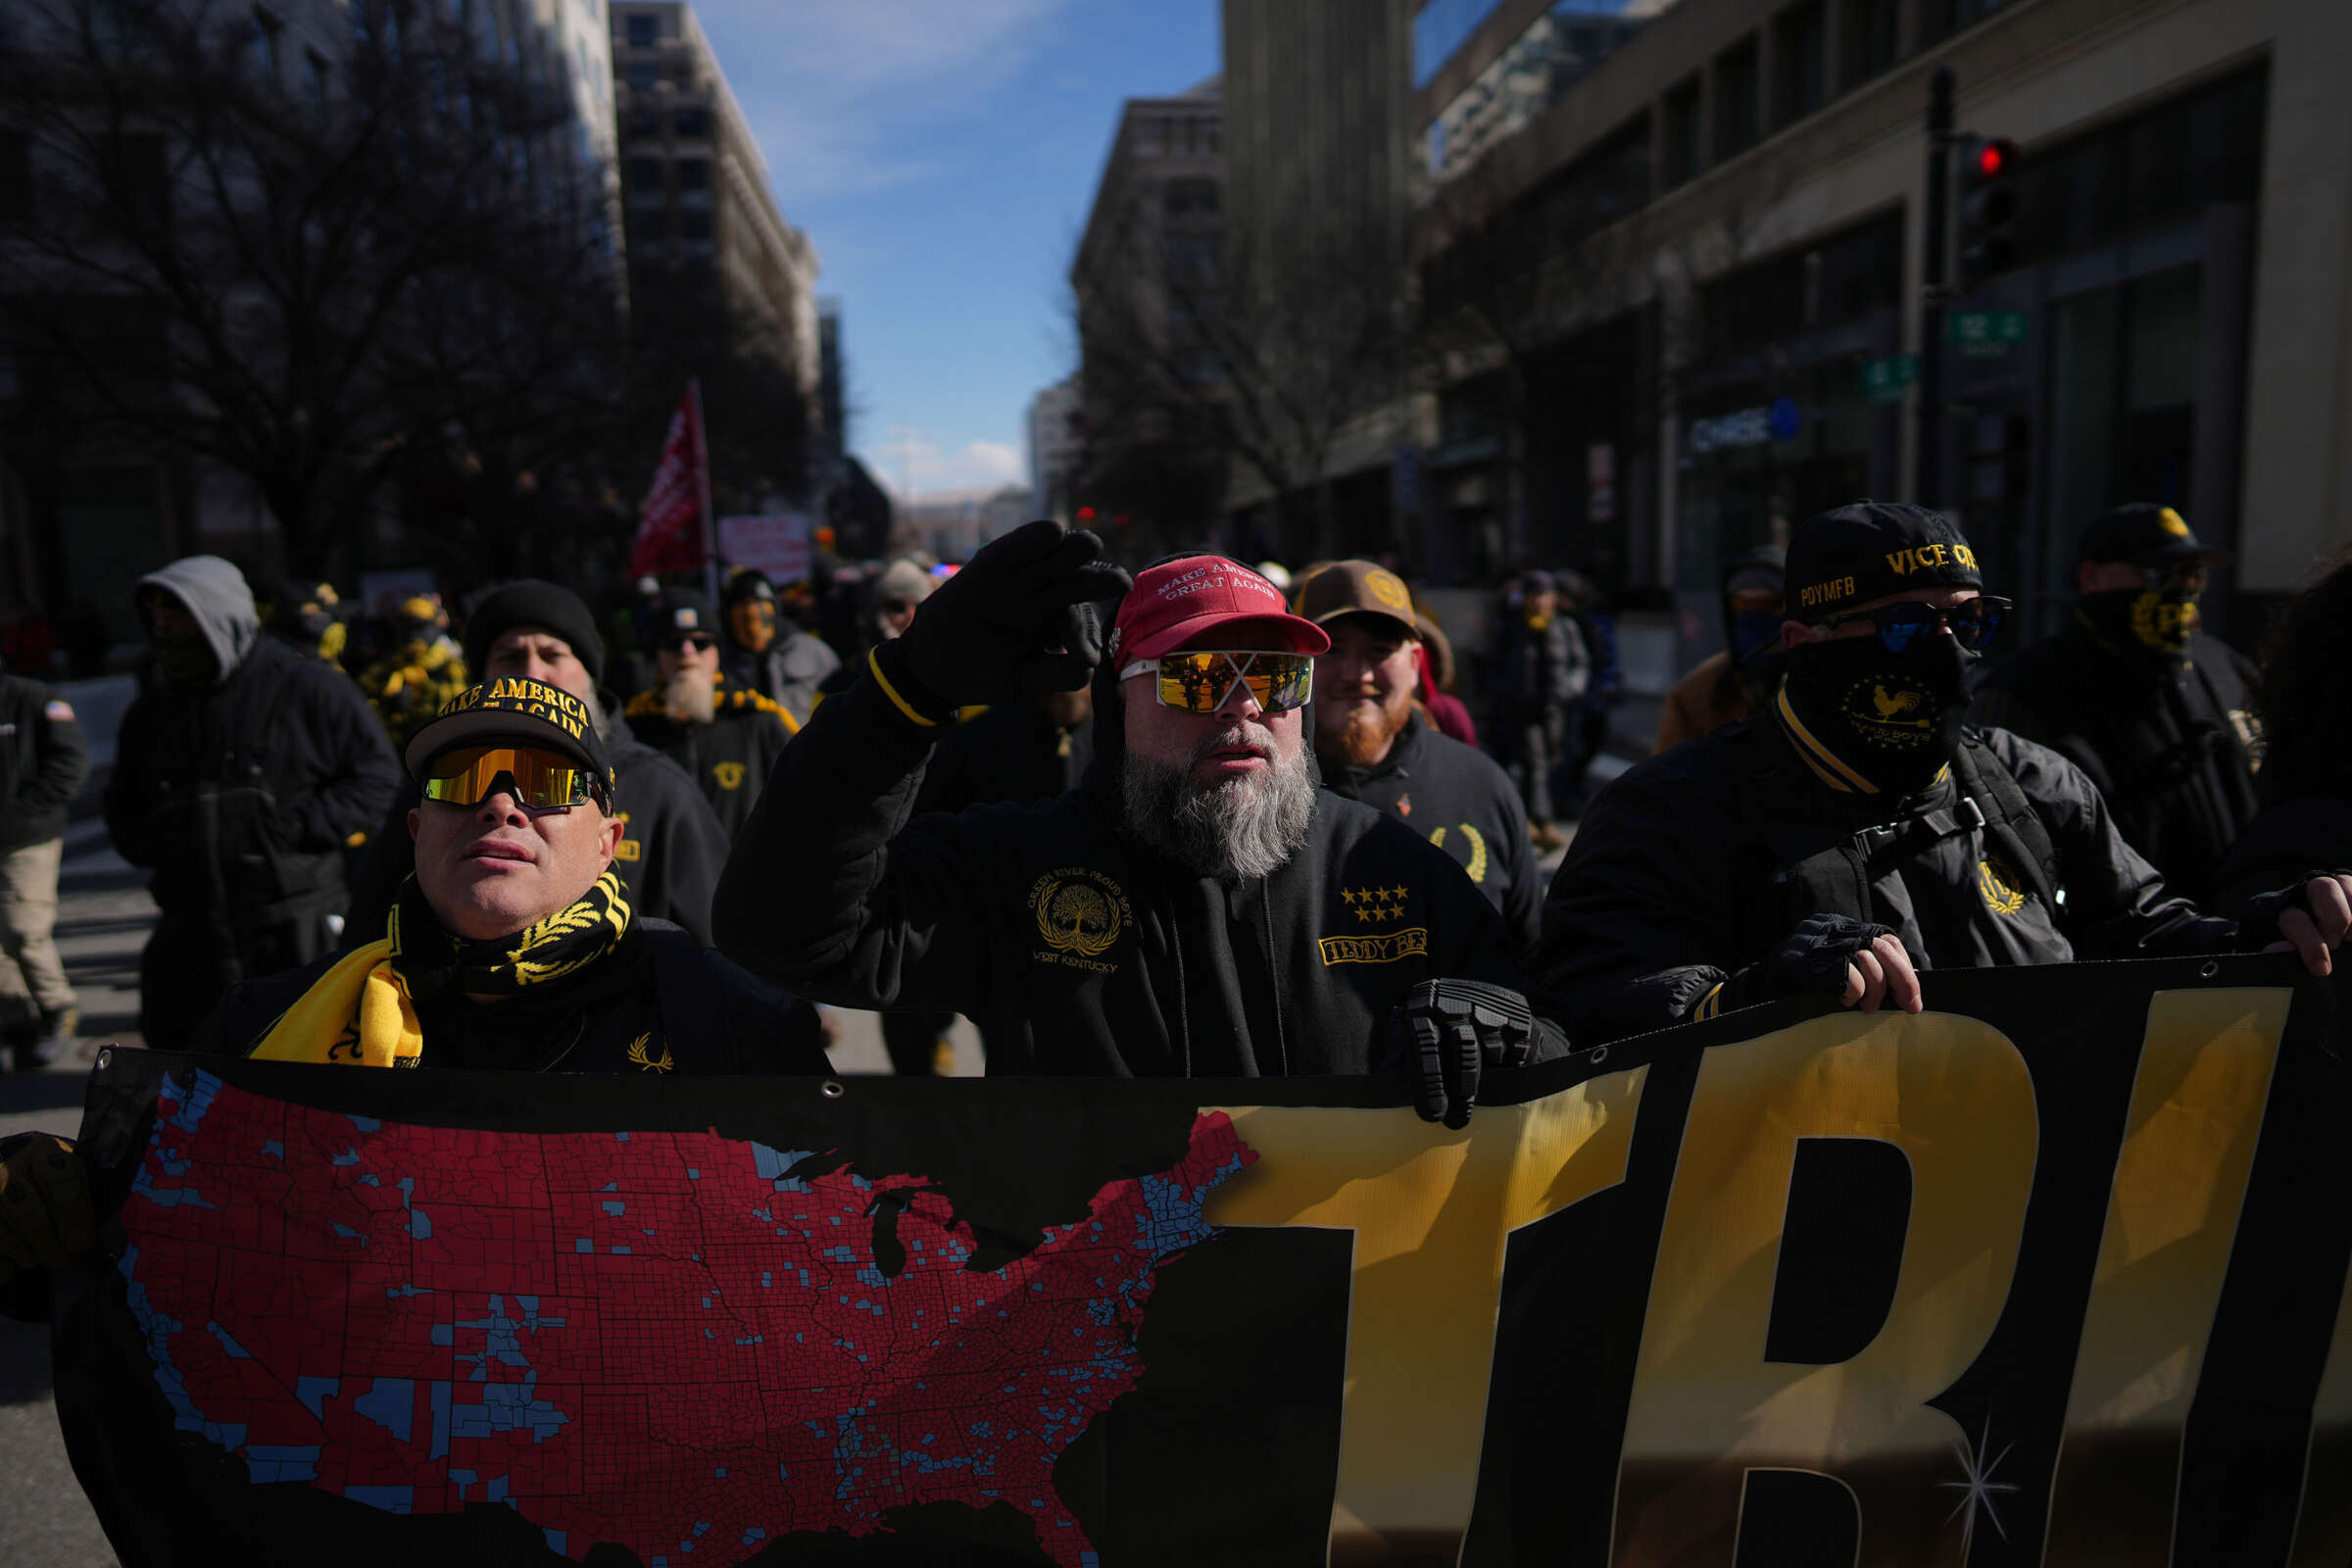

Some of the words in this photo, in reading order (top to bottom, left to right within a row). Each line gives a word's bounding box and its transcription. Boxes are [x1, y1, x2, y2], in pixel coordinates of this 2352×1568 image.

[1885, 544, 1949, 577] VICE
[1156, 568, 1205, 596] MAKE
[1212, 564, 1276, 591] AMERICA
[1165, 578, 1225, 602] GREAT
[1233, 579, 1276, 601] AGAIN
[489, 677, 588, 727] AMERICA
[1325, 940, 1391, 959] TEDDY
[1198, 987, 2352, 1568] TRI
